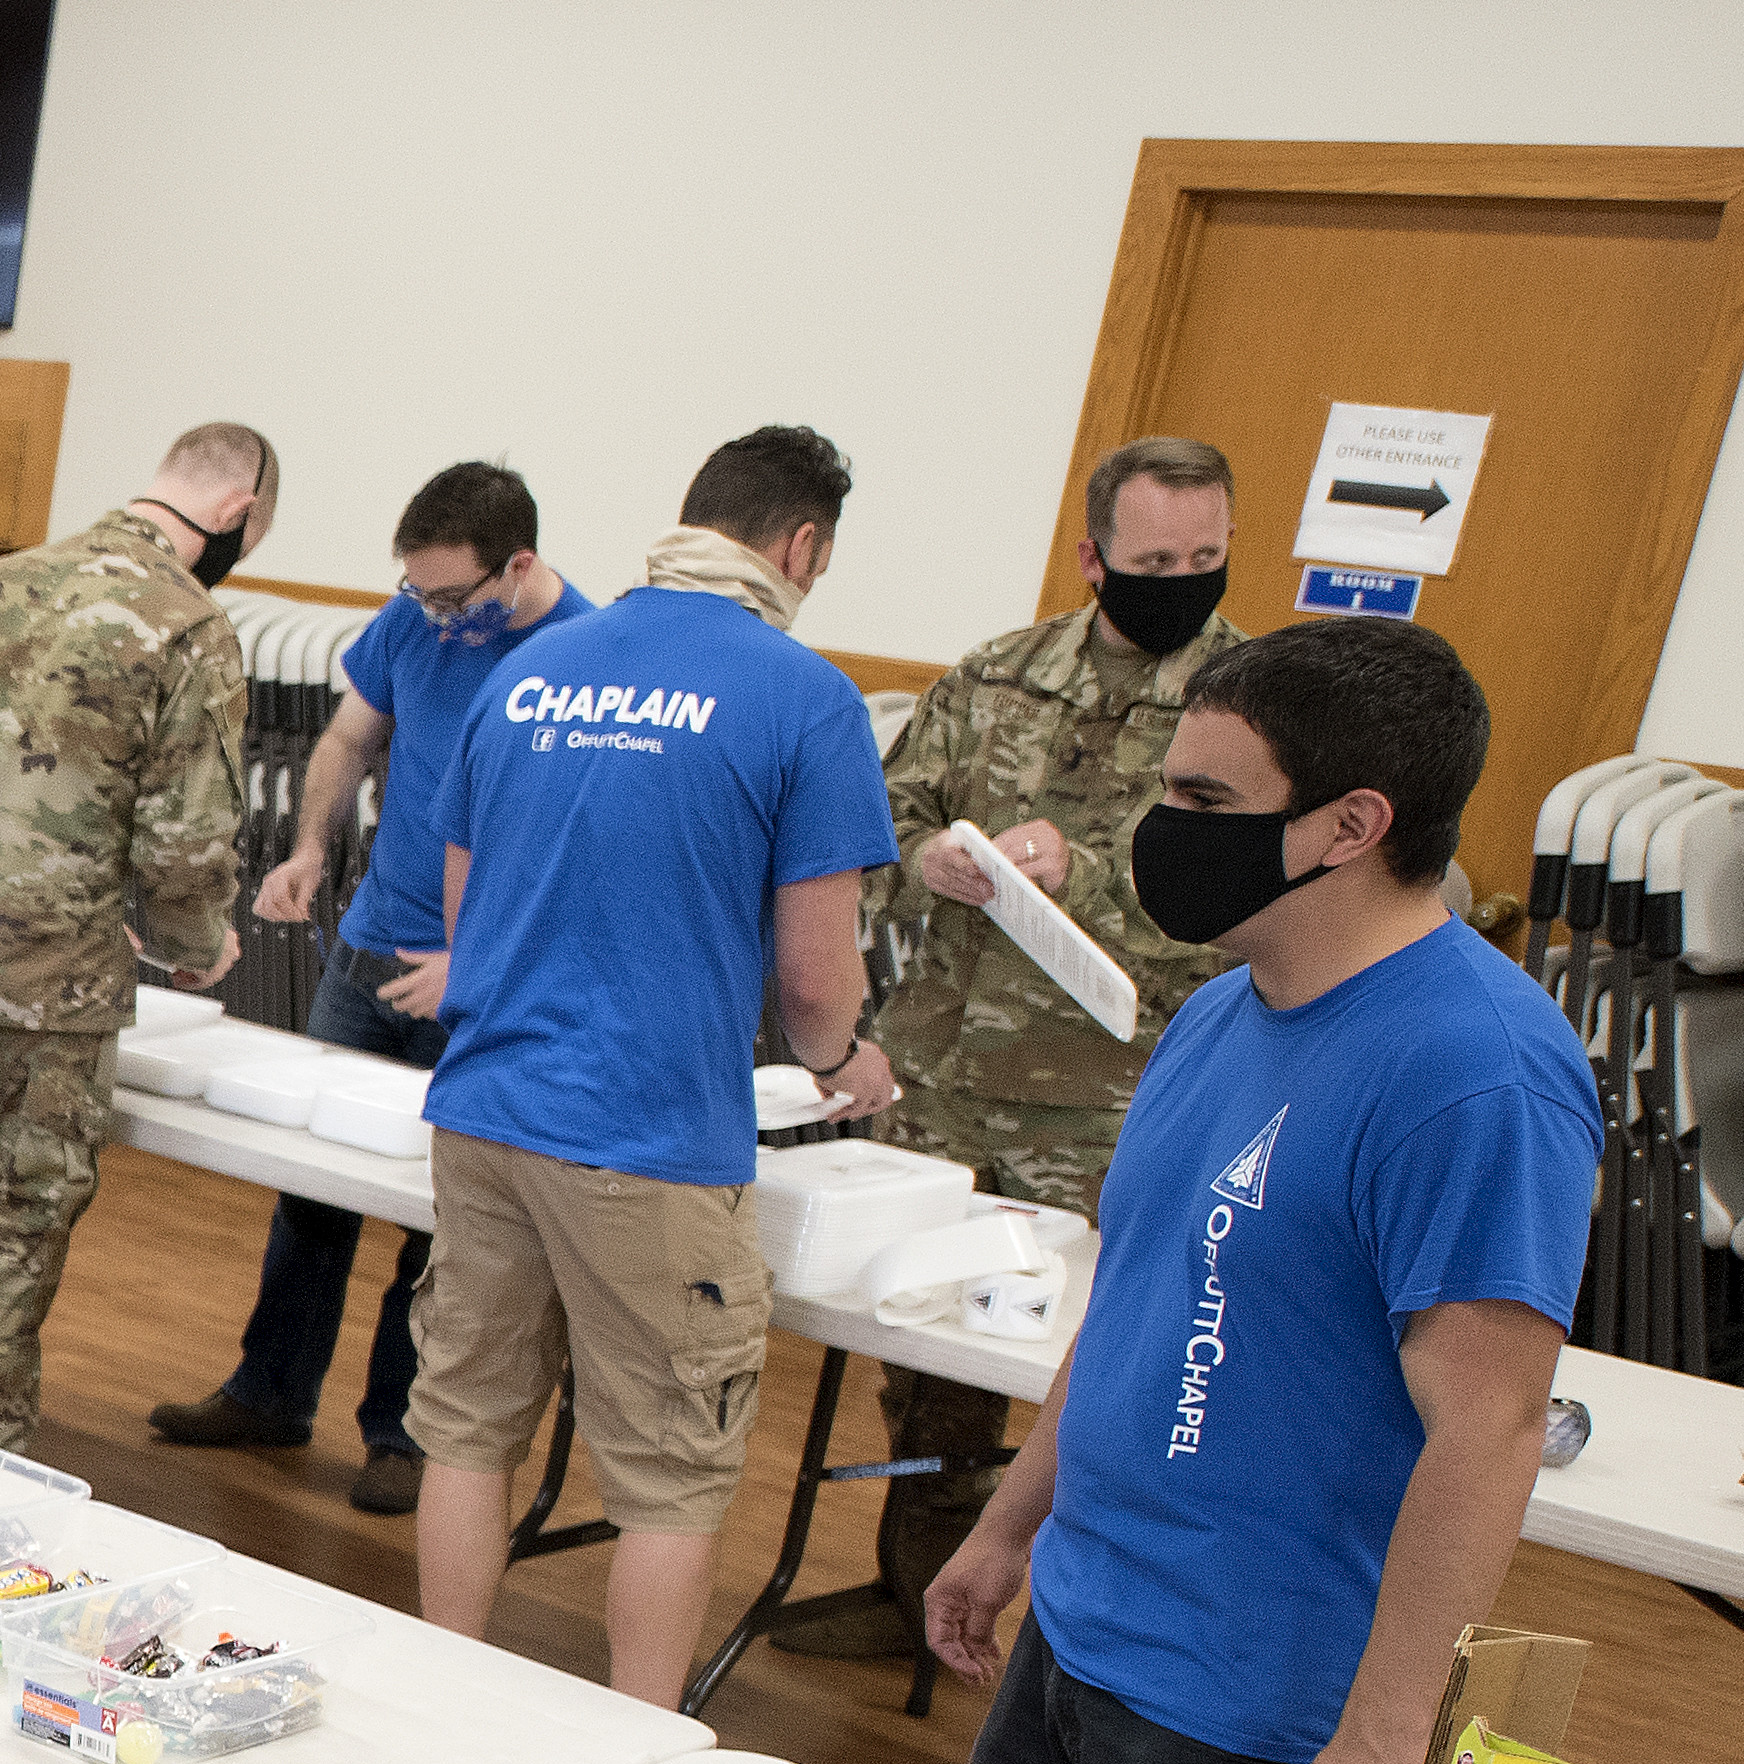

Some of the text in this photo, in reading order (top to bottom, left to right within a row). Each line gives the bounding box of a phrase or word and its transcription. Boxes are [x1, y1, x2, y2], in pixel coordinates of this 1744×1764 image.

[1362, 424, 1447, 445] PLEASE USE
[1335, 444, 1463, 471] OTHER ENTRANCE
[505, 676, 717, 734] CHAPLAIN
[33, 1686, 78, 1710] essentials
[101, 1715, 115, 1733] A
